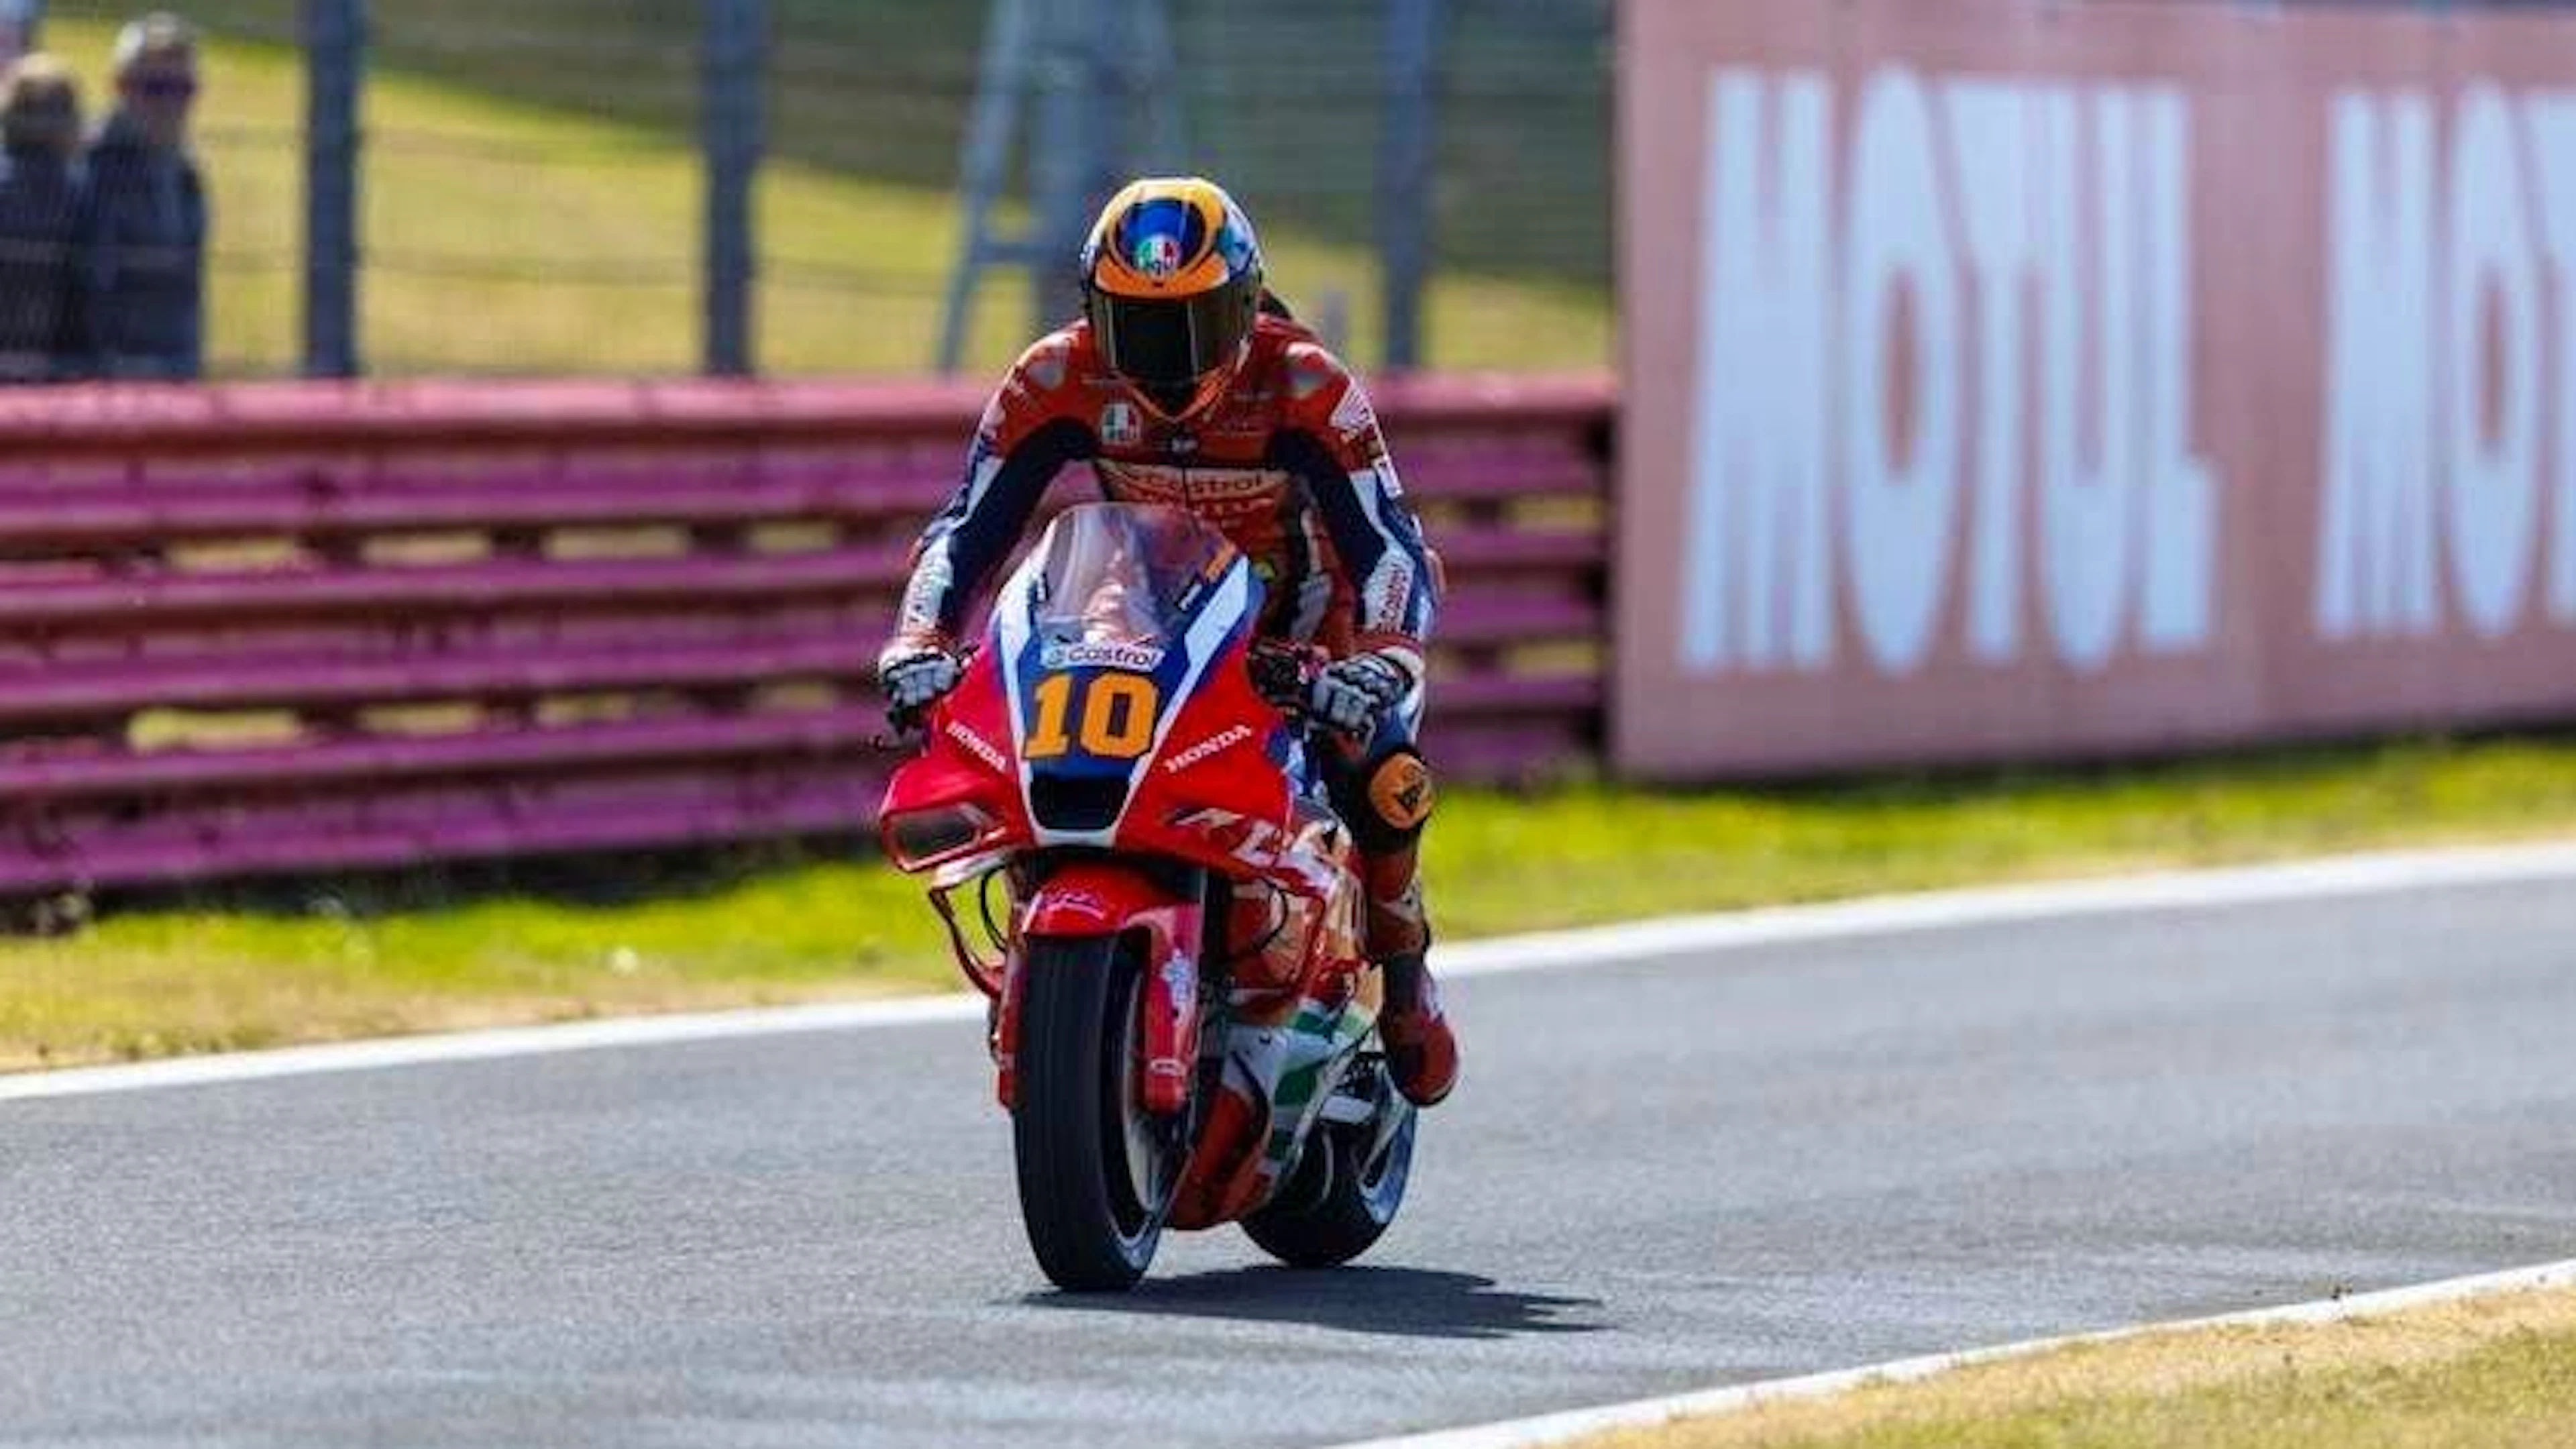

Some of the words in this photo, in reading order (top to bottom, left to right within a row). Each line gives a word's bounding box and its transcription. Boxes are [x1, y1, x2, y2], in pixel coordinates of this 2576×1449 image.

[1678, 66, 2218, 673] MOTUL
[1069, 646, 1157, 666] Castrol
[1024, 671, 1159, 759] 10
[945, 720, 1006, 773] HONDA
[1164, 724, 1252, 773] HONDA
